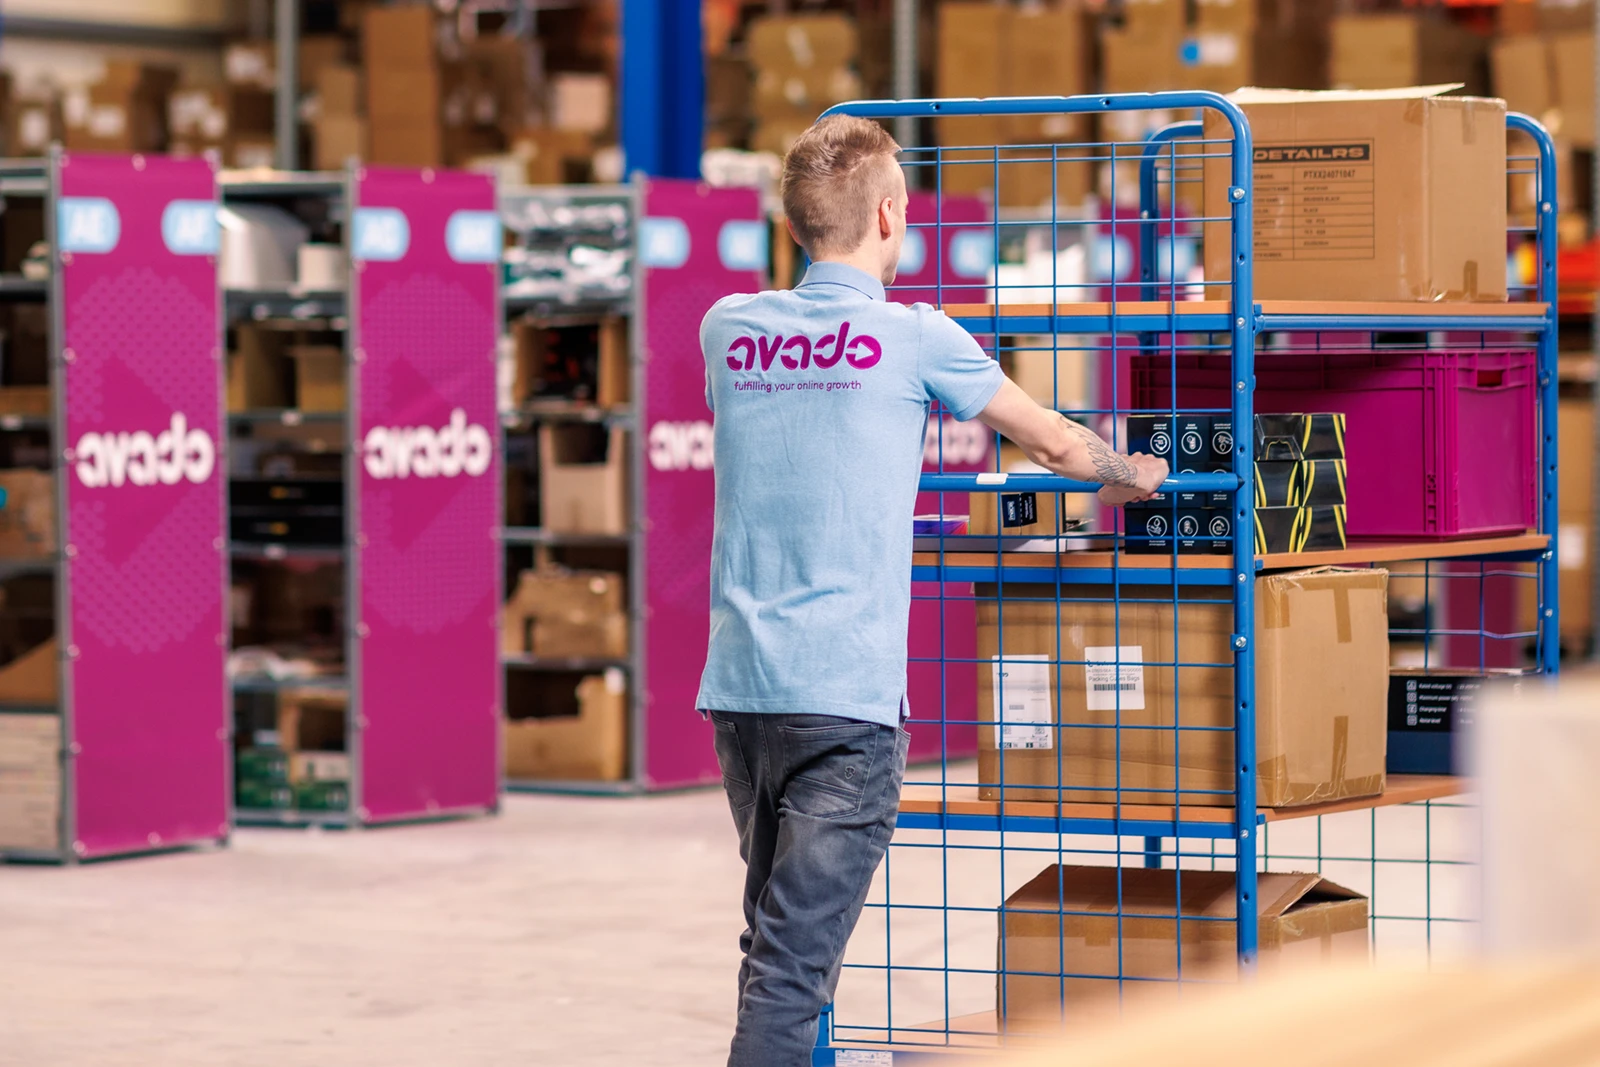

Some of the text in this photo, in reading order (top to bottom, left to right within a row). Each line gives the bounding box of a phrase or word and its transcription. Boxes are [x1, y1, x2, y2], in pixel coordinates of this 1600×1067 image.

[1253, 147, 1364, 161] DETAILRS
[726, 321, 882, 372] avado
[734, 380, 862, 393] fulfilling your online growth
[75, 410, 215, 488] avado
[363, 407, 492, 480] avado
[648, 419, 714, 472] ava
